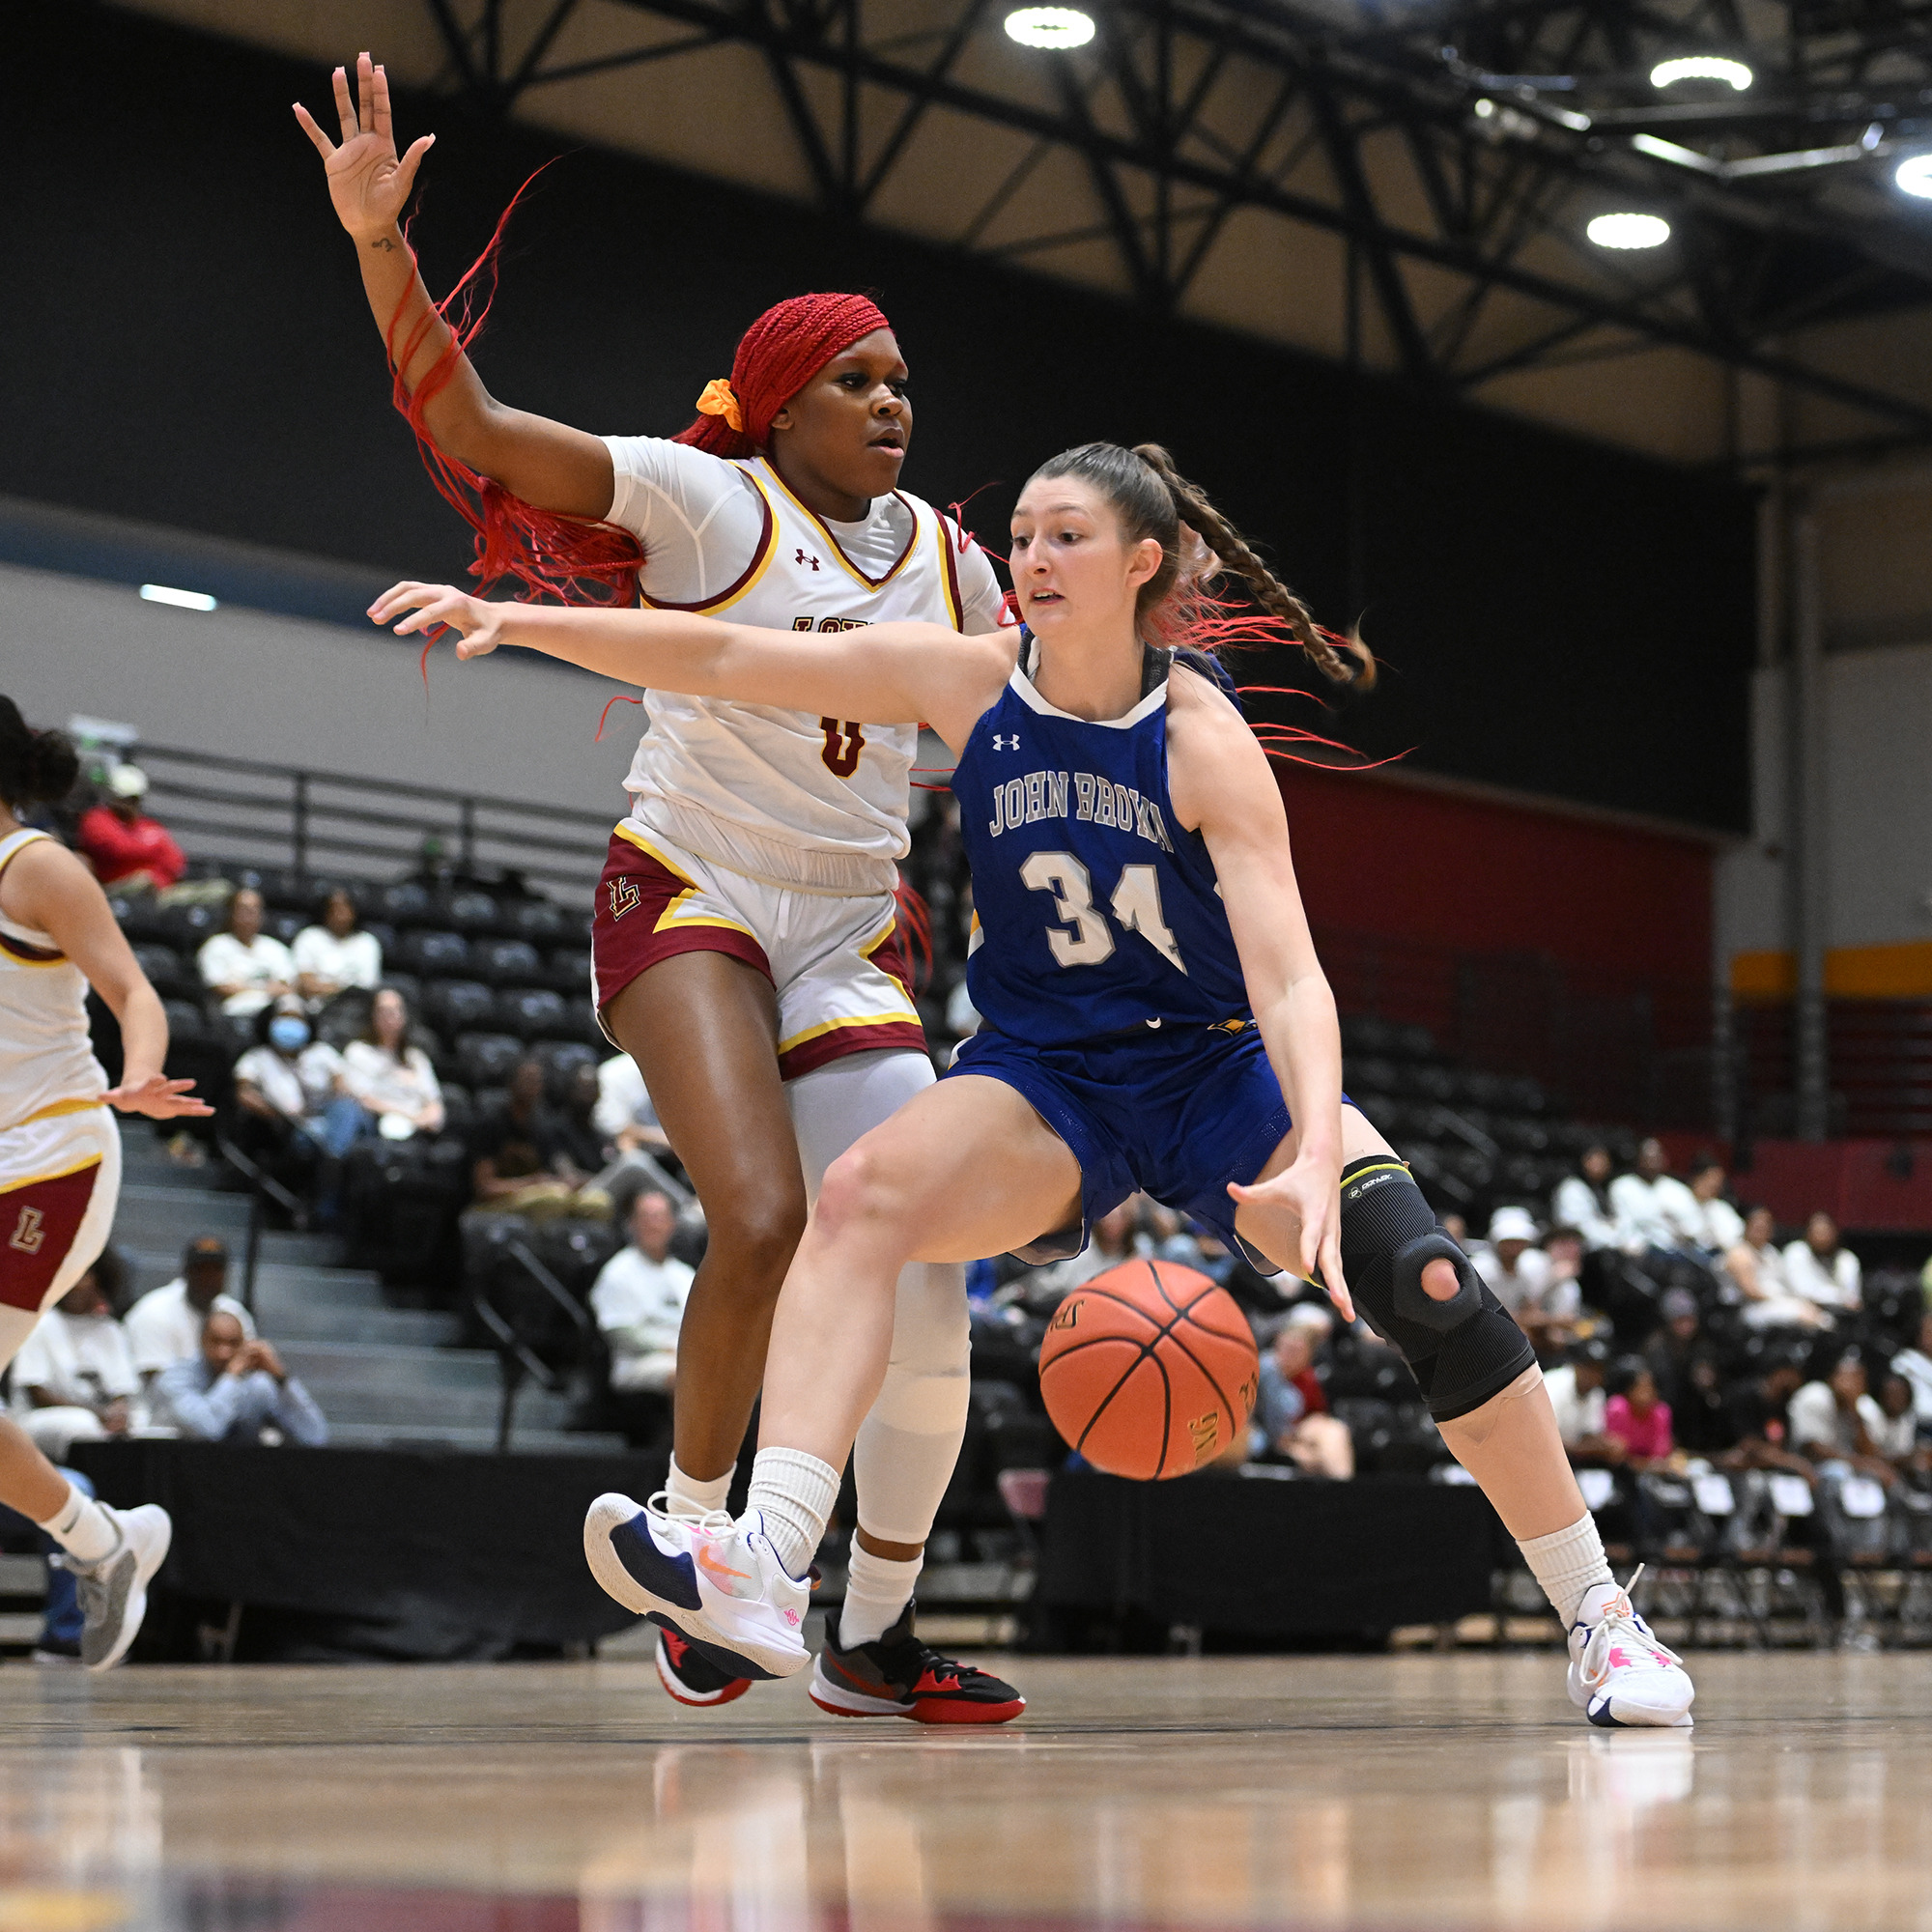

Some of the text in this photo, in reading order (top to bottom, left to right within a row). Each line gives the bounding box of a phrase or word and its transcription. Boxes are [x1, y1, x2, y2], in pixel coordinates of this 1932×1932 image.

[989, 770, 1069, 838] JOHN
[606, 876, 641, 922] L
[1018, 851, 1188, 977] 34
[9, 1205, 46, 1255] L
